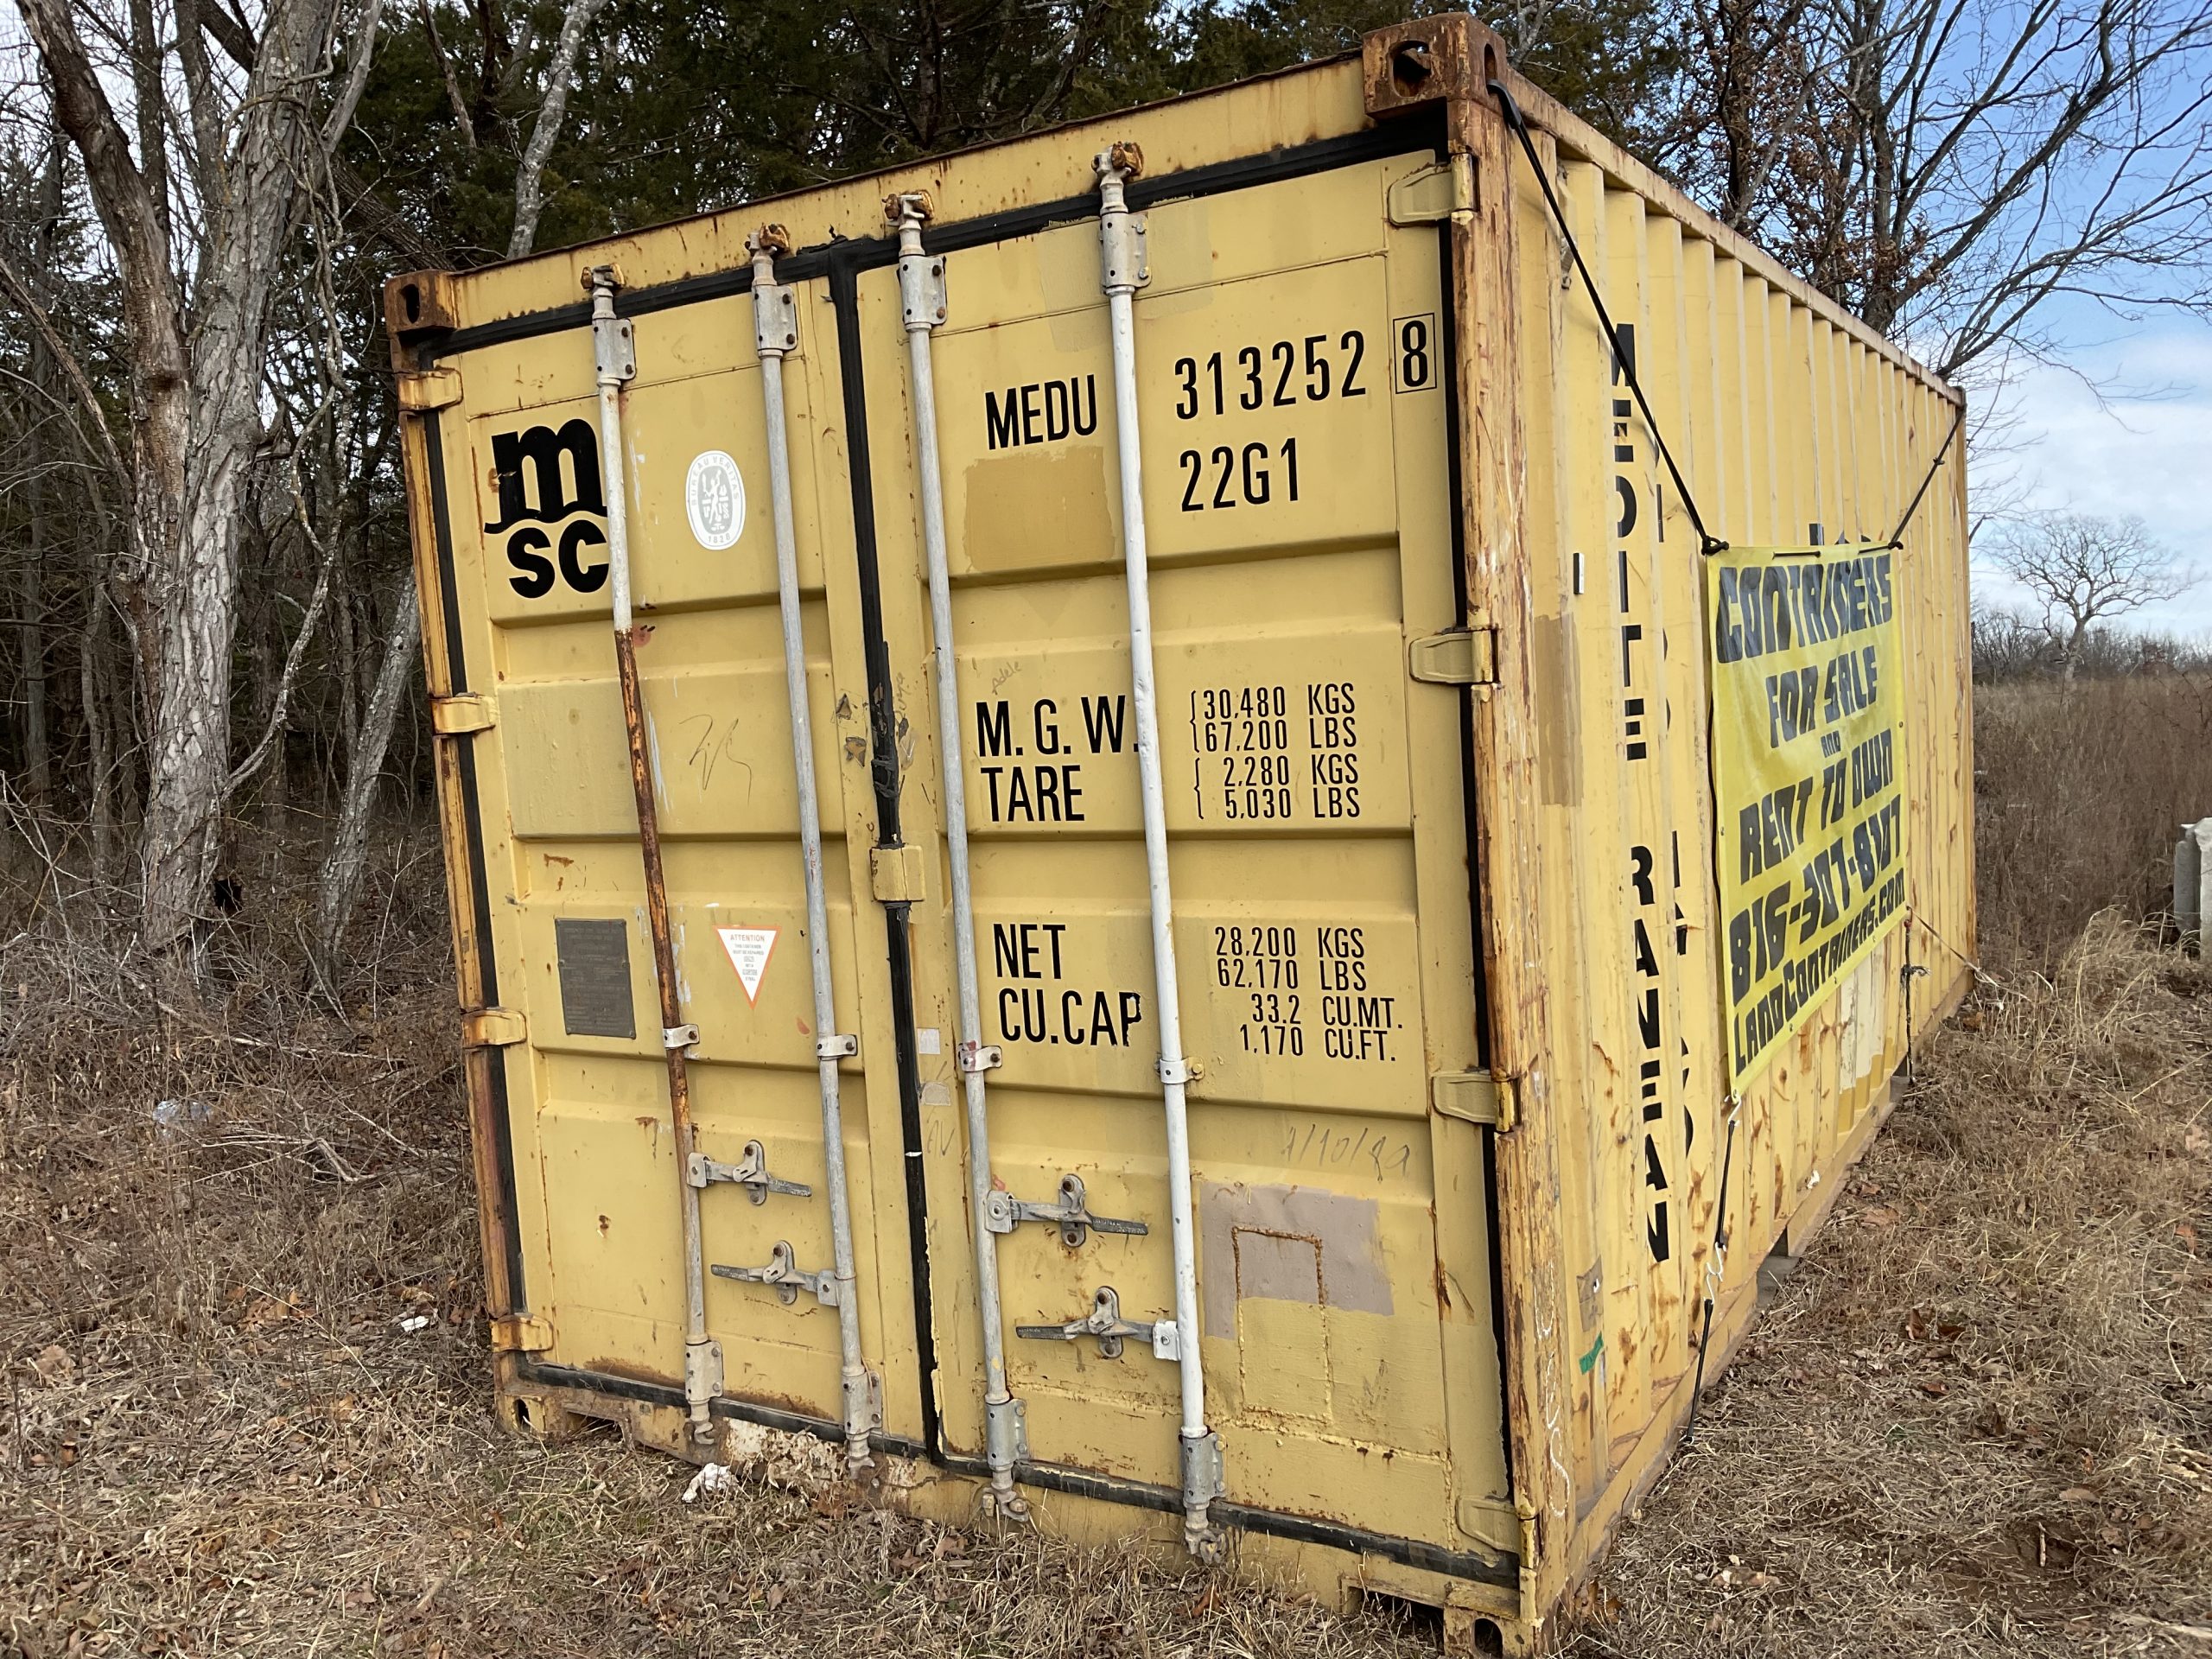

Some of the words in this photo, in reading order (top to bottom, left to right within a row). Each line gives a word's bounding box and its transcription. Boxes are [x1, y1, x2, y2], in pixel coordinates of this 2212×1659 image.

[986, 374, 1097, 450] MEDU
[1174, 330, 1366, 420] 313252
[1401, 320, 1428, 388] 8
[712, 455, 740, 500] VERITAS
[1179, 437, 1299, 512] 22G1
[1203, 686, 1286, 720] 30,480
[1307, 683, 1356, 715] KGS
[1765, 664, 1819, 749] FOR
[1824, 645, 1878, 724] SALE
[1205, 719, 1287, 753] 67,200
[1309, 716, 1357, 749] LBS
[1820, 730, 1841, 759] AND
[980, 765, 1085, 823] TARE
[1223, 755, 1290, 787] 2,280
[1311, 753, 1359, 785] KGS
[1224, 787, 1292, 819] 5,030
[1313, 786, 1361, 818] LBS
[1738, 776, 1814, 886] RENT
[1821, 757, 1847, 832] TO
[1851, 728, 1893, 810] OWN
[993, 923, 1066, 980] NET
[1214, 926, 1296, 957] 28,200
[1317, 927, 1365, 958] KGS
[1217, 957, 1300, 989] 62,170
[1319, 960, 1367, 991] LBS
[999, 988, 1142, 1047] CU.CAP
[1250, 994, 1301, 1025] 33.2
[1322, 995, 1403, 1029] CU.MT.
[1239, 1024, 1304, 1057] 1,170
[1324, 1027, 1396, 1062] CU.FT.
